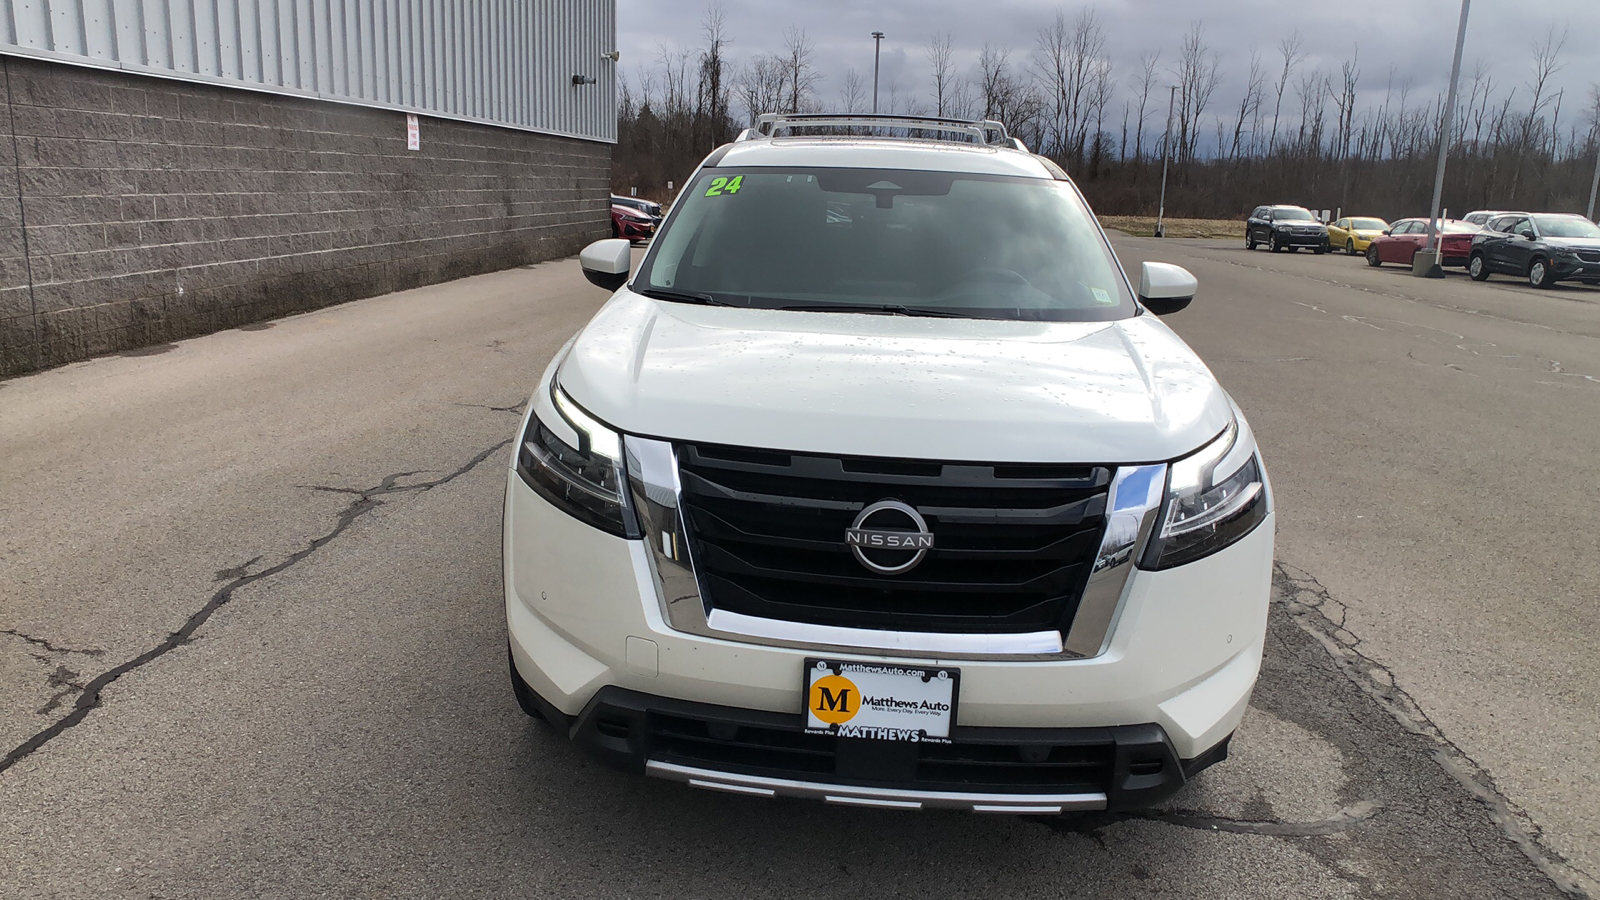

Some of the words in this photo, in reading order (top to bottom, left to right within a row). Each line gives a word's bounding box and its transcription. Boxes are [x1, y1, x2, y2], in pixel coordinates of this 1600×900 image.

[705, 175, 743, 197] 24
[847, 531, 932, 547] NISSAN
[839, 663, 926, 677] MatthewsAuto.com
[816, 686, 851, 713] M
[862, 694, 918, 709] Matthews
[920, 699, 949, 711] Auto
[837, 725, 920, 743] MATTHEWS
